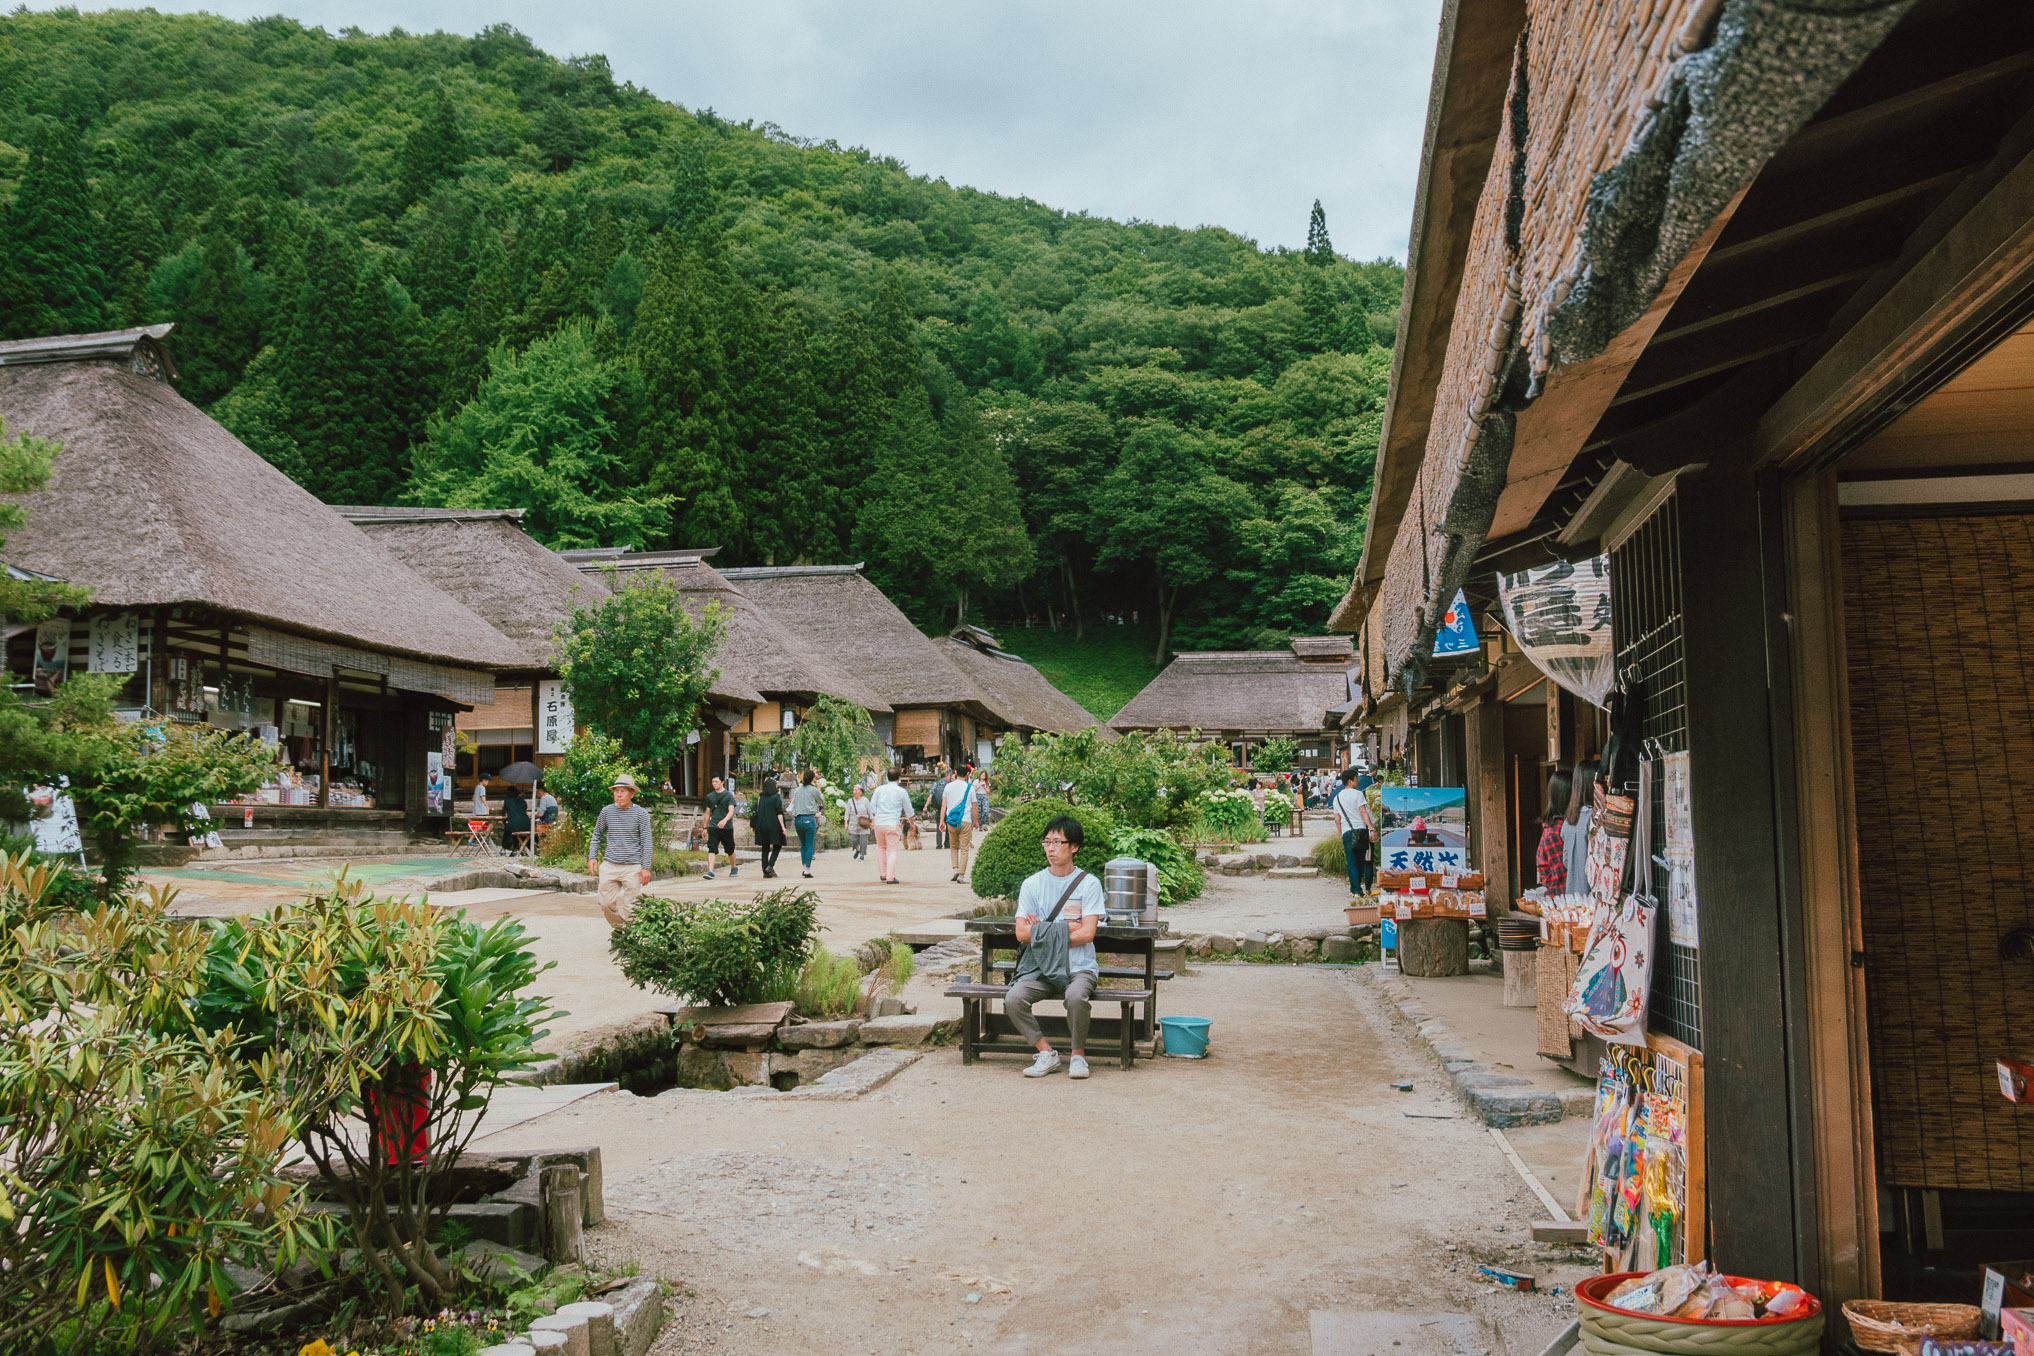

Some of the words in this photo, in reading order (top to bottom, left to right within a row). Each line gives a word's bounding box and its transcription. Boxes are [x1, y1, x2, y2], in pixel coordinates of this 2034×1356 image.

[546, 701, 558, 744] 石原屋
[1390, 850, 1459, 872] 天然氷
